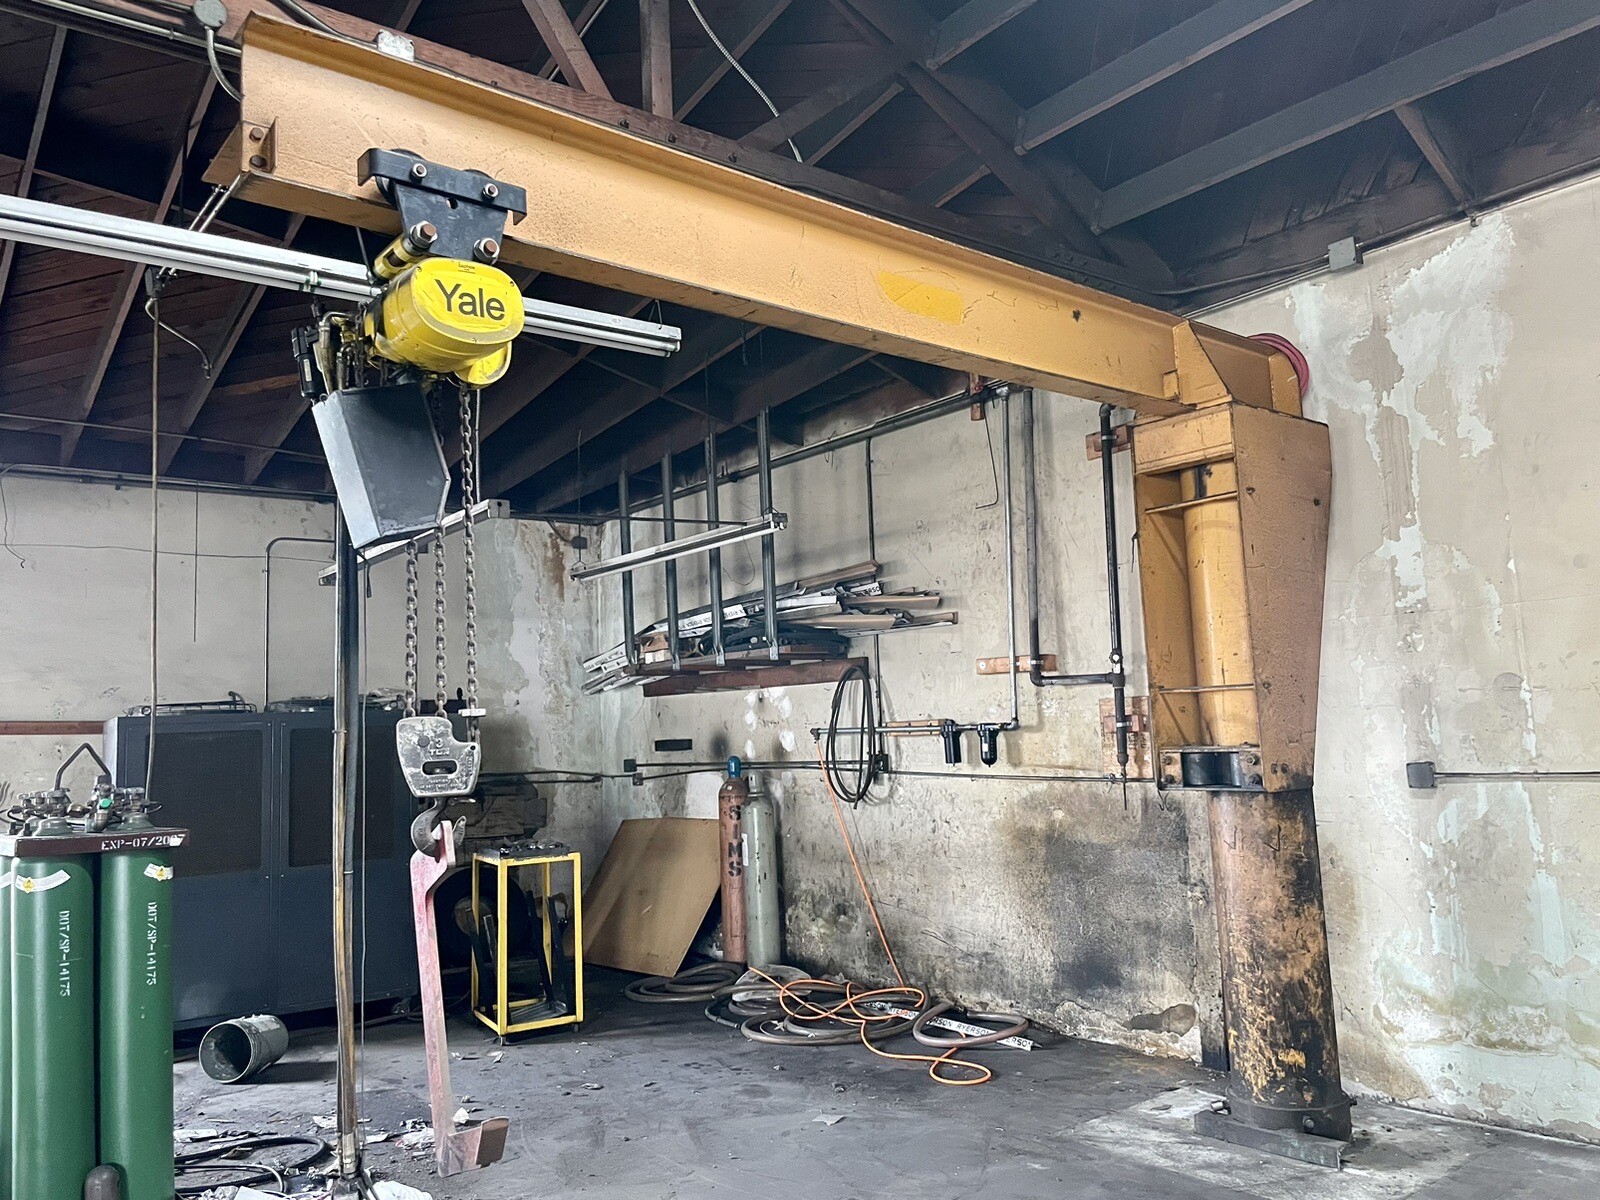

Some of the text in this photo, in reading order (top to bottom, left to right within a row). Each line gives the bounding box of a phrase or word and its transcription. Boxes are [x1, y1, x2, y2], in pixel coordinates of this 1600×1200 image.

[434, 279, 505, 320] Yale
[435, 738, 443, 748] 3
[728, 804, 743, 877] SIMS
[59, 910, 71, 997] DOT/SP-14175
[146, 901, 158, 986] DOT/SP-14175
